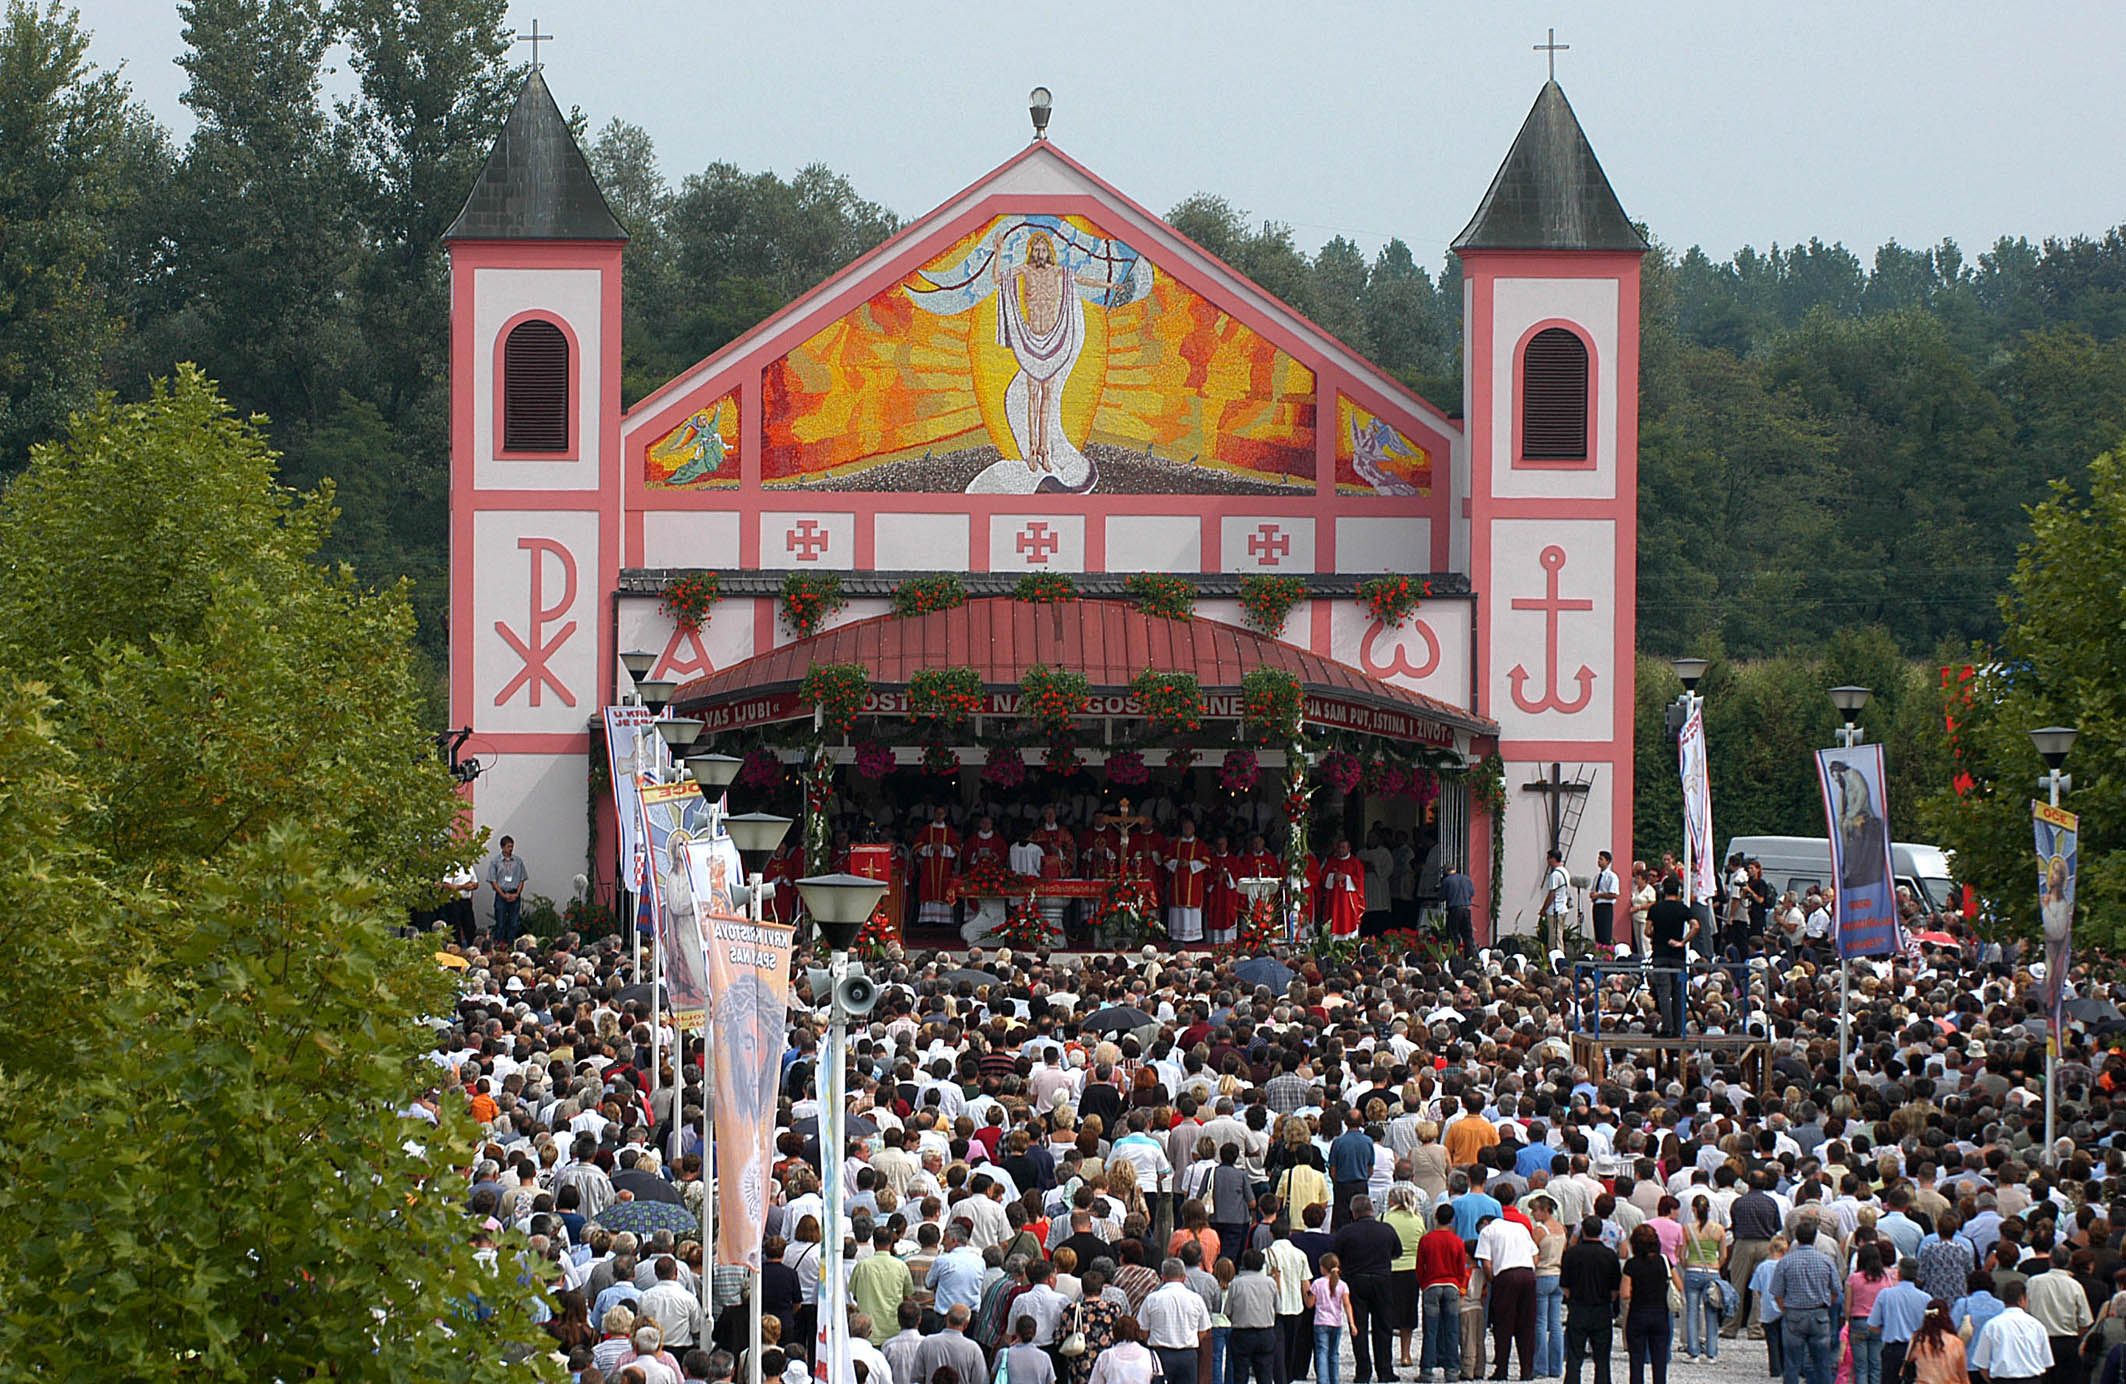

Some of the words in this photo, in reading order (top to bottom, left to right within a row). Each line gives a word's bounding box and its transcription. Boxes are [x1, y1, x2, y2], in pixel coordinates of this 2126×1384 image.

[704, 708, 729, 728] VAS
[1324, 702, 1346, 723] SAM
[1373, 711, 1406, 736] ISTINA
